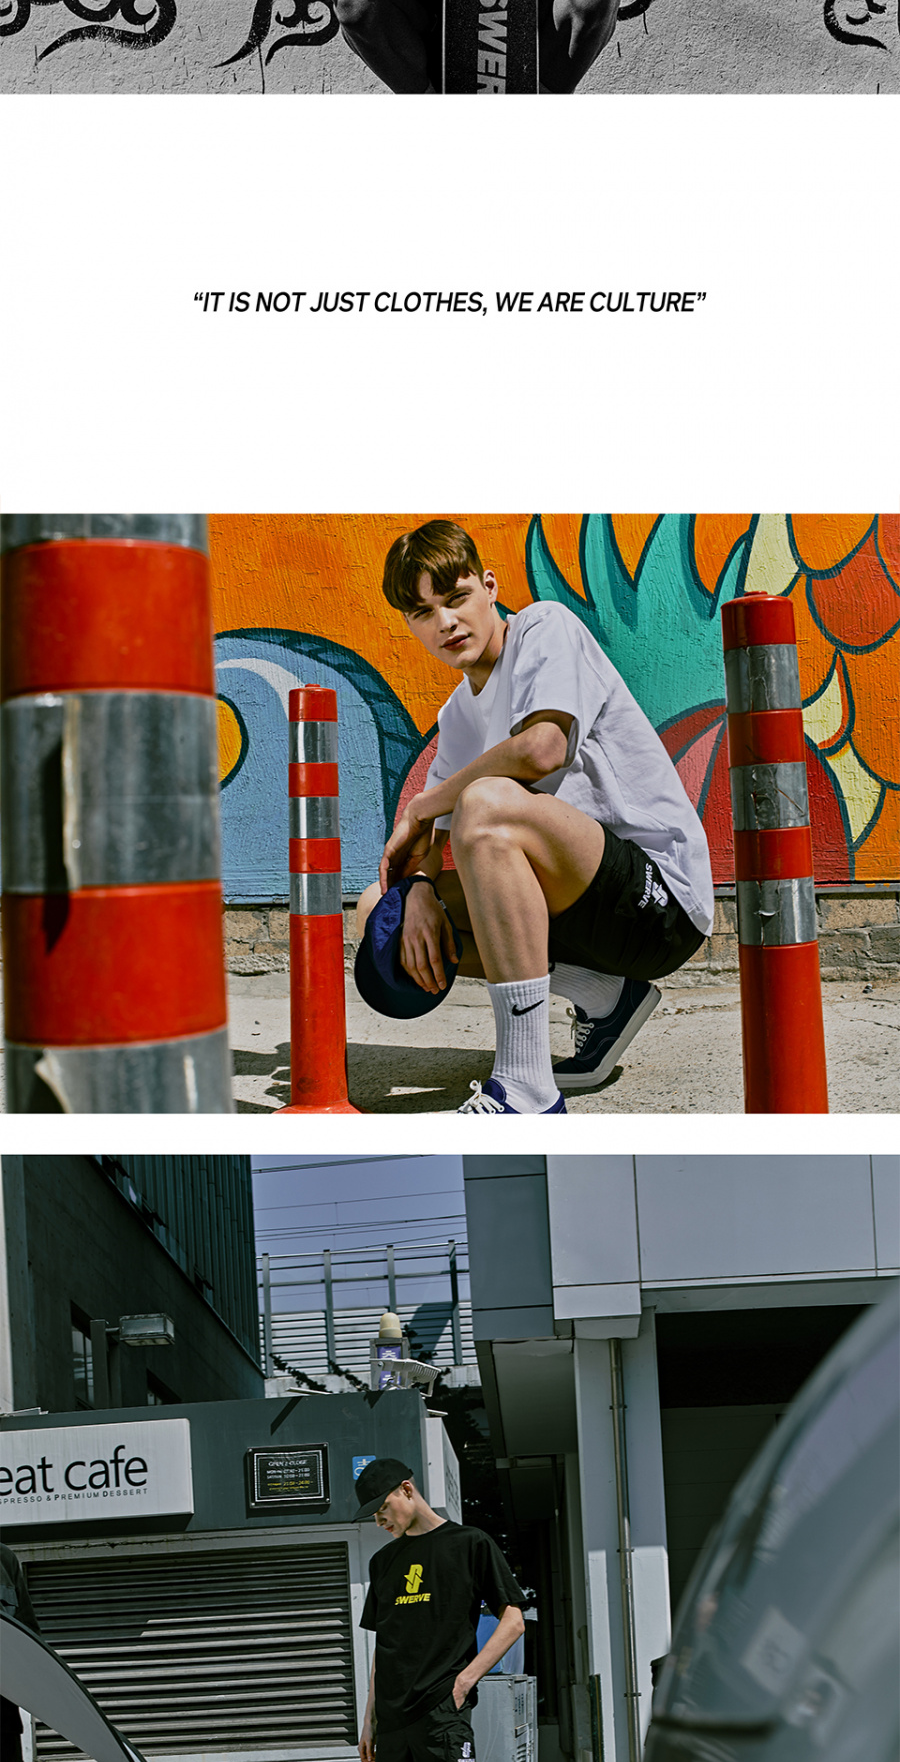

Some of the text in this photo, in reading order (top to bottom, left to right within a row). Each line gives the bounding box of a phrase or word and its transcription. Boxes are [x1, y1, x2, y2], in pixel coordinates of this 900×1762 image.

[637, 863, 653, 909] SWERVE
[65, 1444, 149, 1488] cafe
[54, 1491, 100, 1500] PREMIUM
[102, 1488, 148, 1497] DESSERT
[394, 1593, 431, 1605] SWERVE
